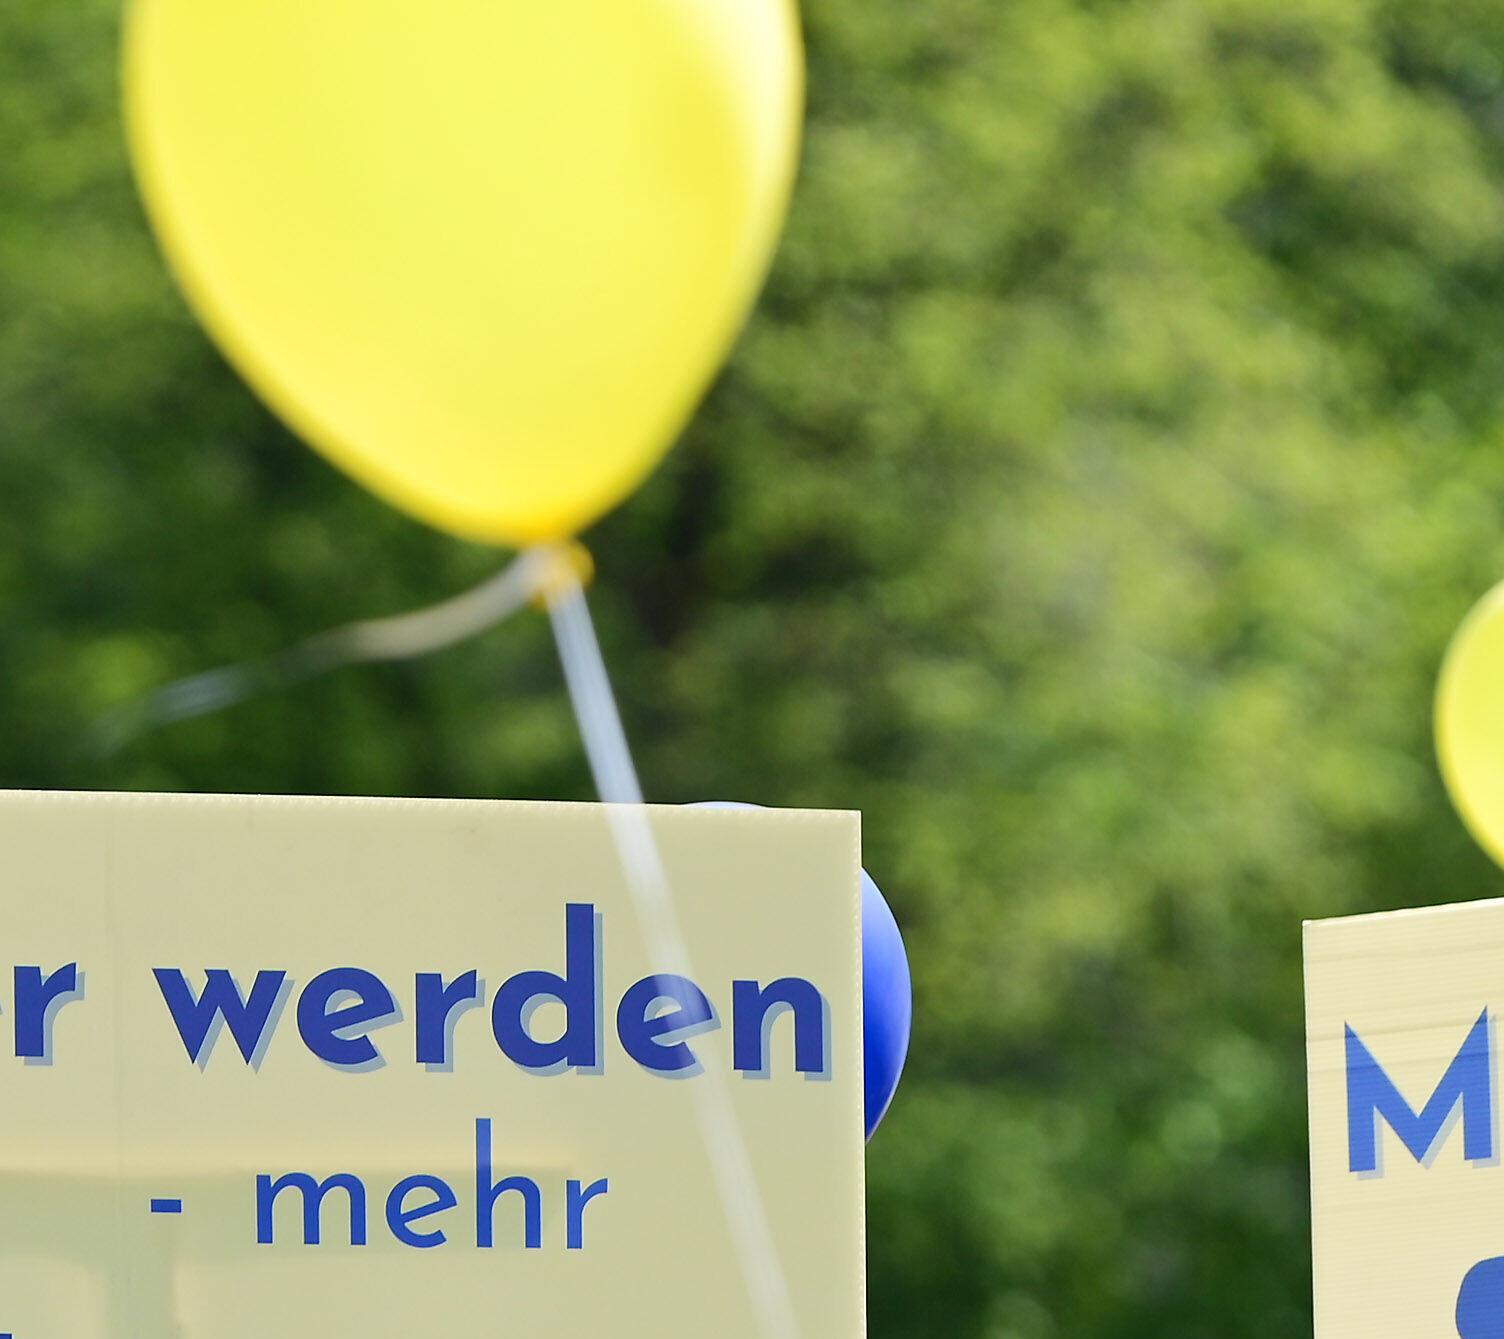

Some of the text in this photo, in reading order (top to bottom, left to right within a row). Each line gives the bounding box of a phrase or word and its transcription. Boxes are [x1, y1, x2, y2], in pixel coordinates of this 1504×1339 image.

[151, 902, 833, 1080] werden
[150, 1117, 609, 1251] - mehr
